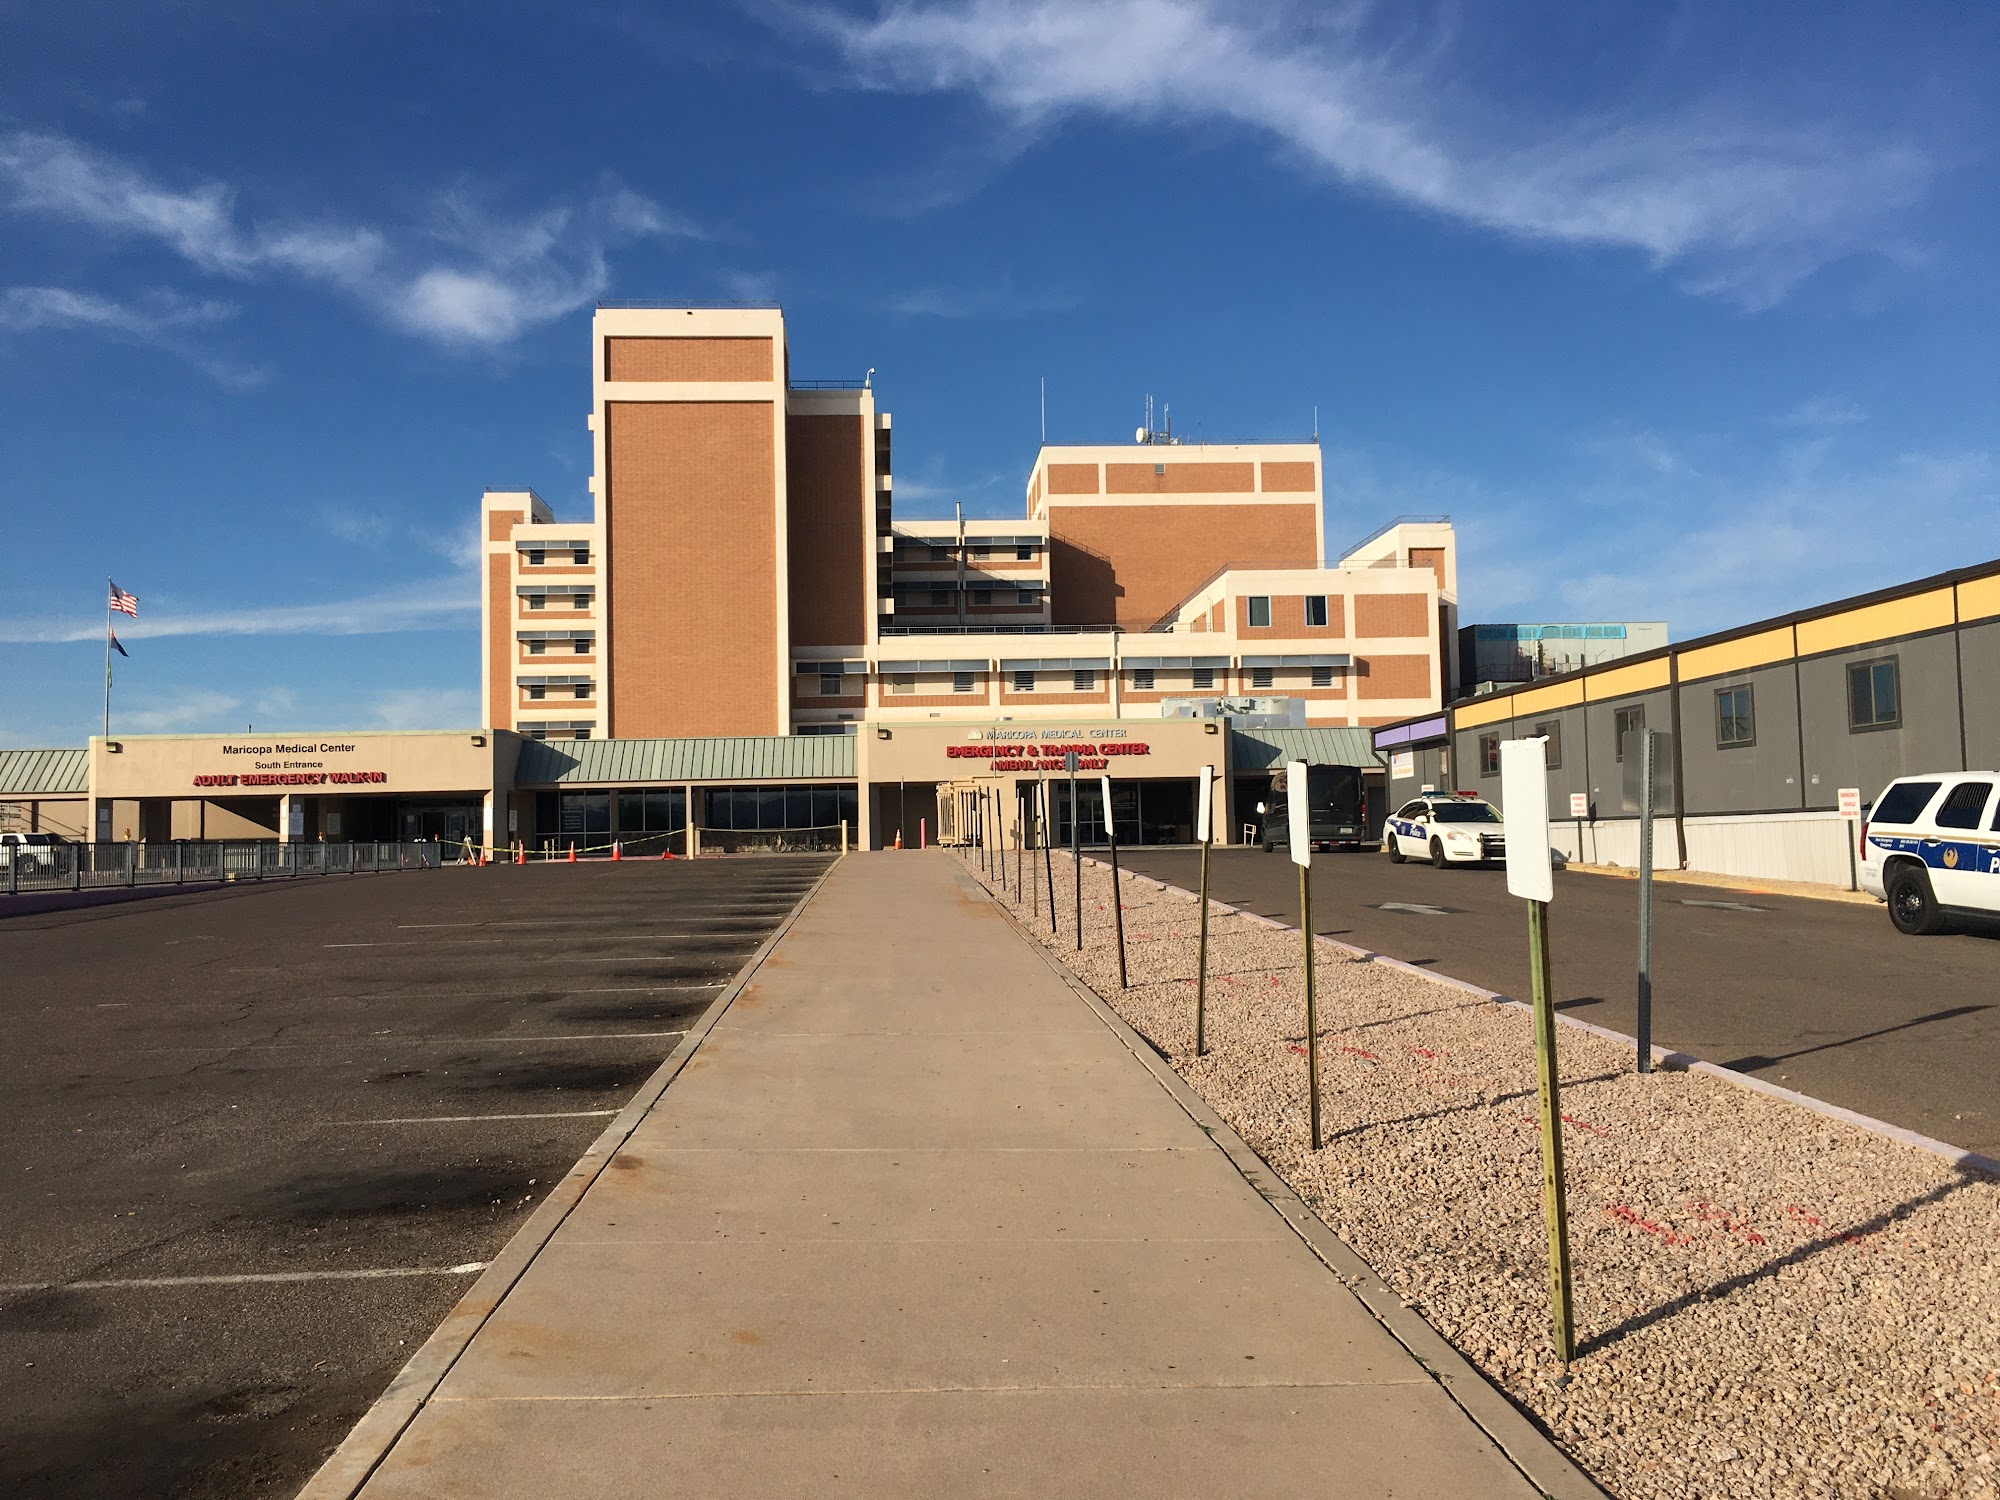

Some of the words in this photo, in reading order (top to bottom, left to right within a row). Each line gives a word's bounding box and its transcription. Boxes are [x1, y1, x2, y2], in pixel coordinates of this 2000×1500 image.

[986, 730, 1037, 740] MARICOPA
[1041, 729, 1083, 739] MEDICAL
[1089, 728, 1127, 738] CENTER
[222, 745, 273, 756] Maricopa
[275, 744, 317, 753] Medical
[320, 743, 355, 753] Center
[947, 745, 1024, 758] EMERGENCY
[1026, 744, 1040, 757] &
[1040, 743, 1097, 757] TRAUMA
[1099, 743, 1150, 755] CENTER
[255, 761, 281, 770] South
[283, 760, 323, 769] Entrance
[193, 774, 237, 787] ADULT
[239, 772, 326, 786] EMERGENCY
[327, 771, 387, 784] WALK-IN
